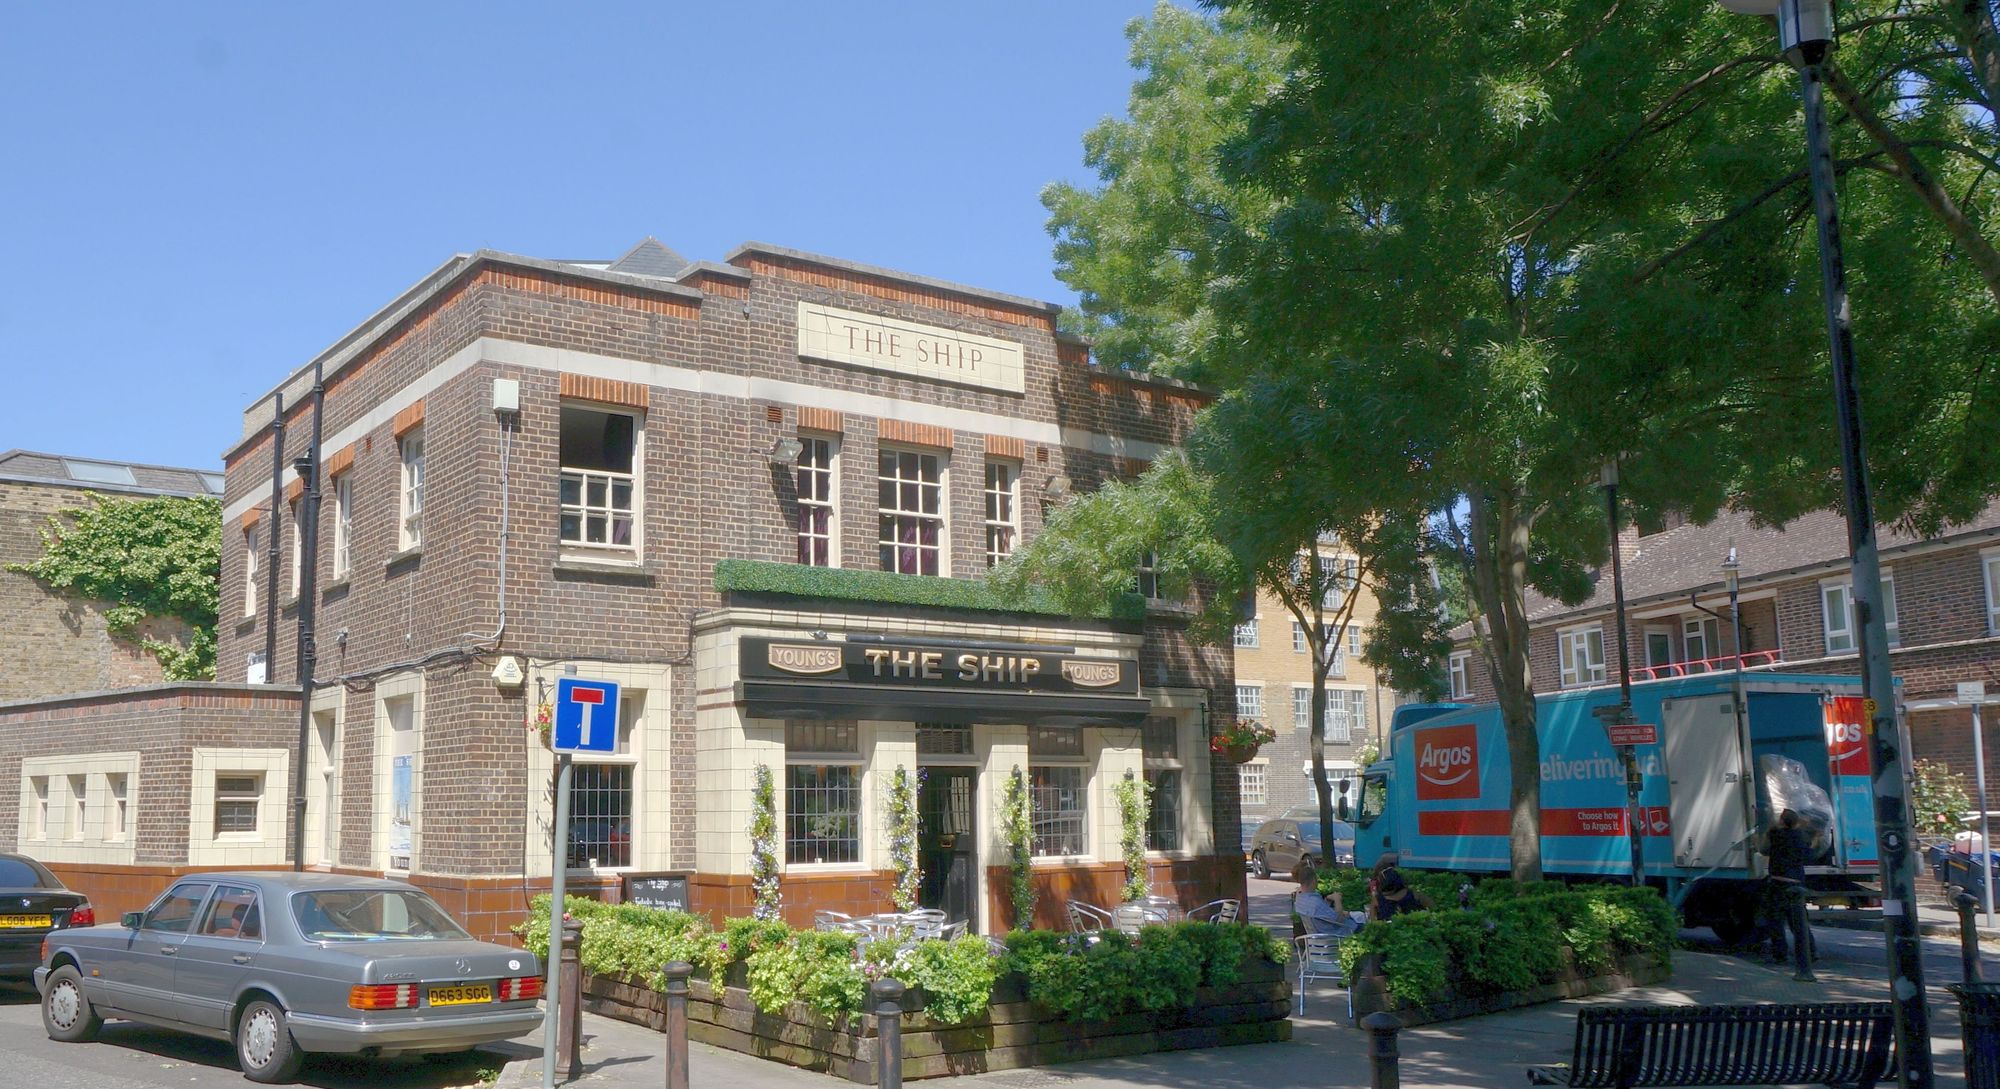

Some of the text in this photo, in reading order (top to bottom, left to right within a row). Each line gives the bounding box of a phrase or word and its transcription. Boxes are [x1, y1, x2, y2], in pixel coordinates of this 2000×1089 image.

[843, 325, 983, 371] THE SHIP
[774, 648, 836, 666] YOUNG'S
[865, 648, 1041, 683] THE SHIP
[1068, 665, 1115, 680] YOUNG'S
[1420, 743, 1471, 774] Argos
[1540, 752, 1628, 785] elivering
[1578, 811, 1618, 820] Choose how
[1583, 822, 1590, 830] to
[1592, 822, 1611, 832] Argos
[430, 987, 489, 1003] D663 SGG
